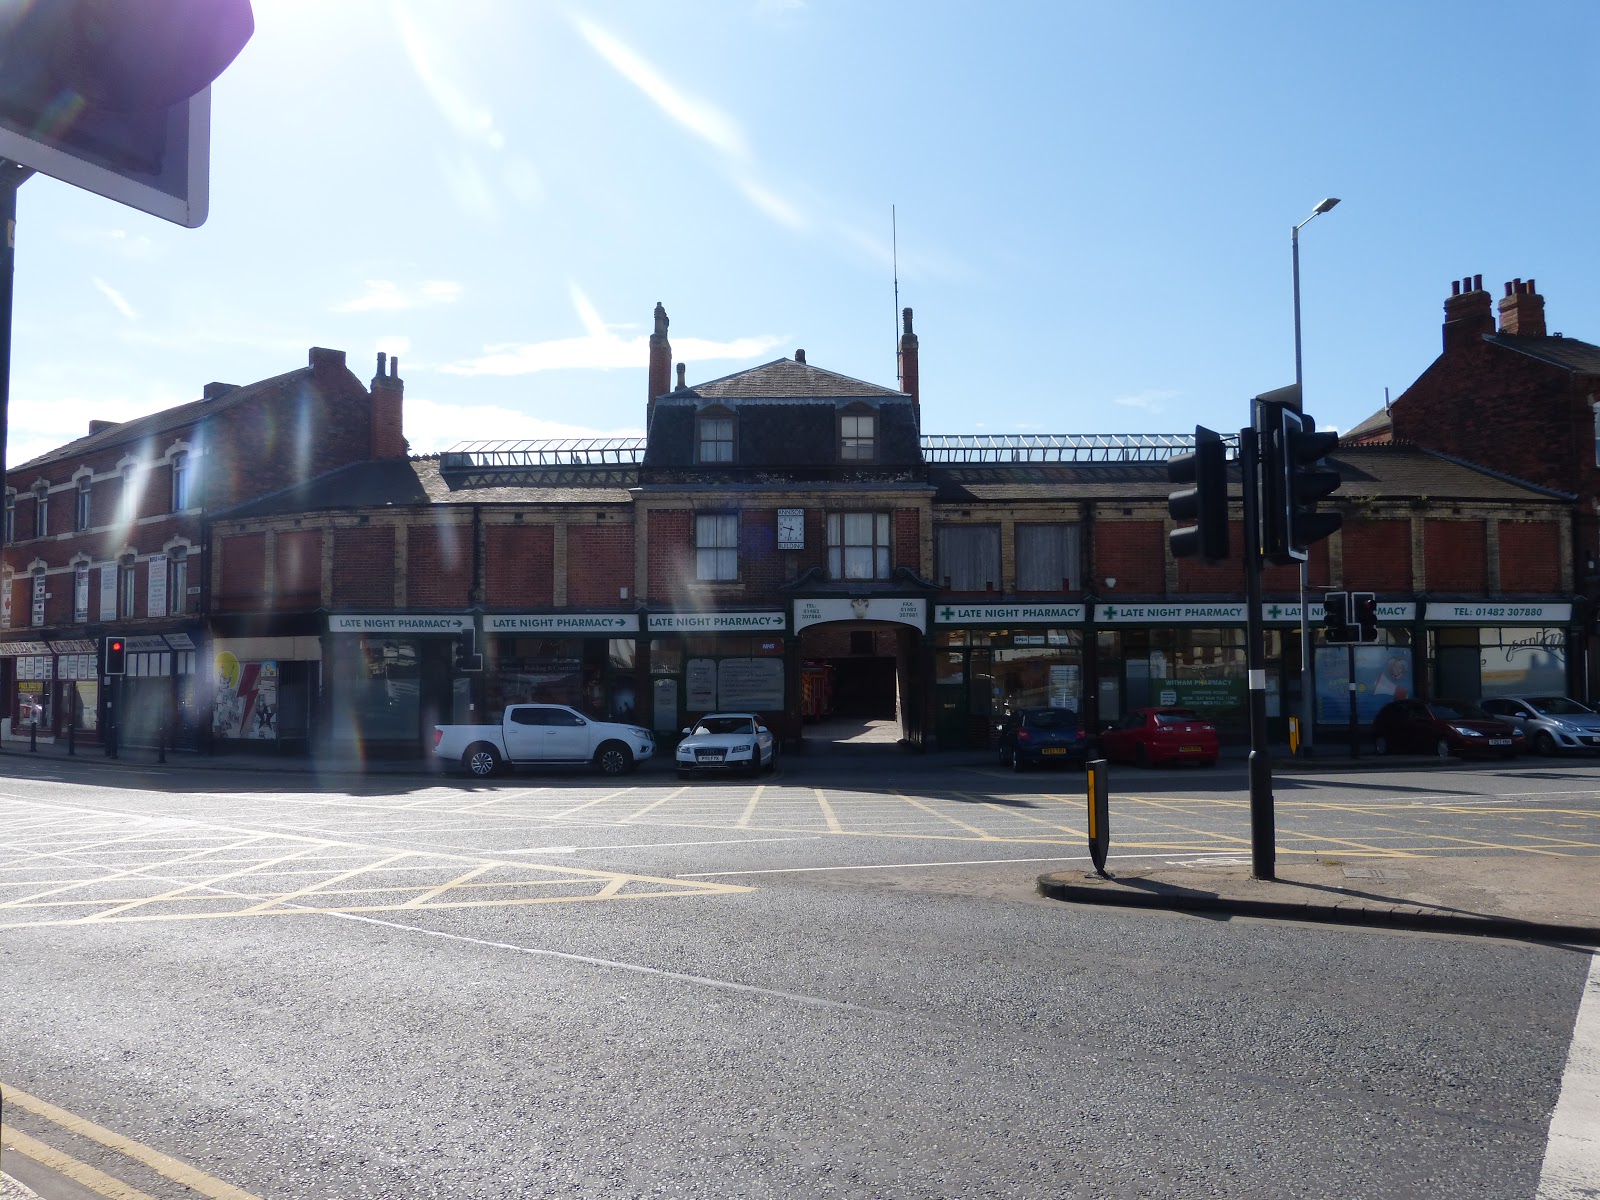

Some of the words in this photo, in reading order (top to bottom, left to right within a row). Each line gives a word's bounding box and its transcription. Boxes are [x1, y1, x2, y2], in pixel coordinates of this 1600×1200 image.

[958, 609, 982, 618] LATE
[985, 609, 1020, 617] NIGHT
[1022, 608, 1081, 617] PHARMACY
[1120, 609, 1144, 617] LATE
[1147, 608, 1182, 617] NIGHT
[1184, 608, 1243, 617] PHARMACY
[1285, 608, 1301, 616] LAT
[1454, 607, 1473, 616] TEL:
[1475, 607, 1505, 616] 01482
[1507, 607, 1543, 616] 307880
[339, 619, 361, 628] LATE
[364, 619, 396, 628] NIGHT
[398, 619, 452, 628] PHARMACY
[493, 619, 516, 628] LATE
[519, 619, 554, 628] NIGHT
[557, 618, 614, 627] PHARMACY
[649, 618, 673, 627] LATE
[676, 617, 711, 626] NIGHT
[714, 617, 772, 626] PHARMACY
